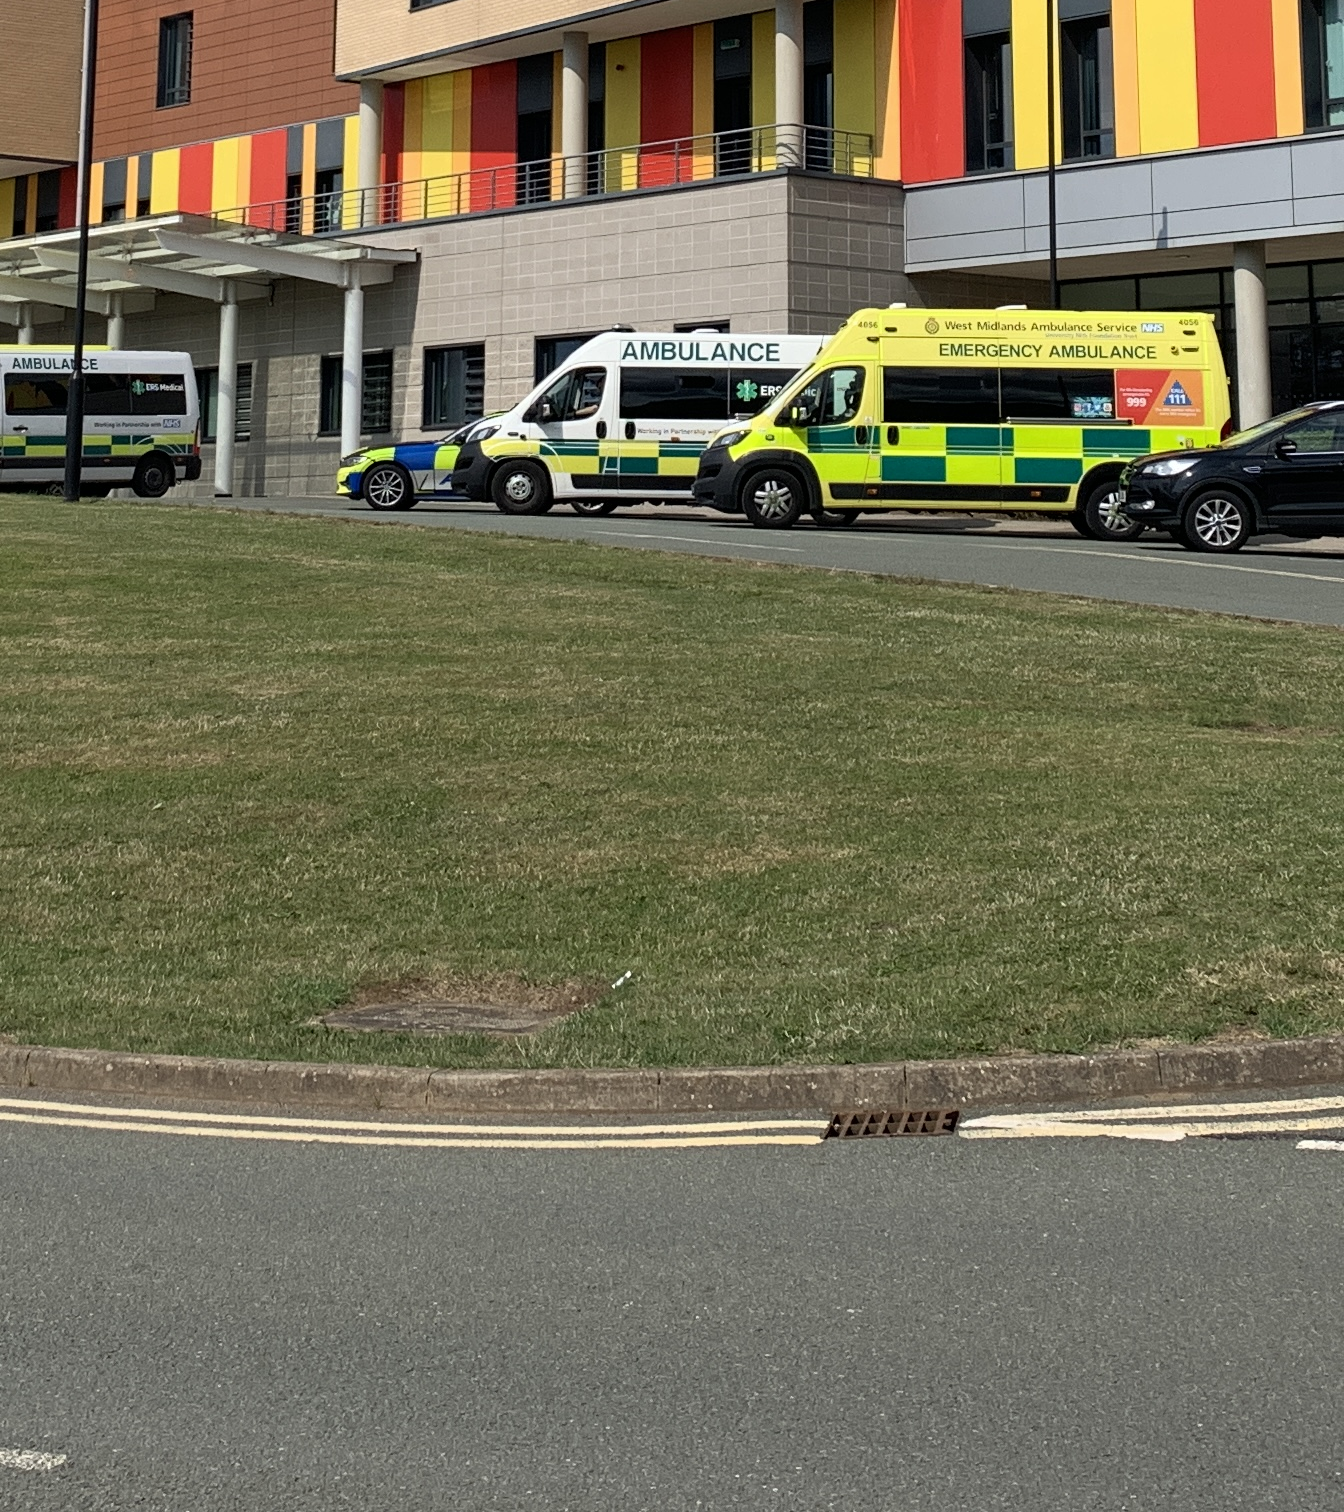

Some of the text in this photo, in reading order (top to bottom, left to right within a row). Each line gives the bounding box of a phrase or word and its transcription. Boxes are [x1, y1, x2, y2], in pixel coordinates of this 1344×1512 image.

[857, 321, 879, 329] 4056
[944, 320, 1164, 333] West Midlands Ambulance Service NHS
[1179, 318, 1199, 326] 4056
[621, 341, 781, 362] AMBULANCE
[938, 343, 1158, 359] EMERGENCY AMBULANCE
[159, 383, 184, 391] Medical
[1126, 397, 1147, 407] 999
[1168, 394, 1186, 405] 111
[637, 427, 662, 436] Working
[670, 428, 706, 436] Partnership
